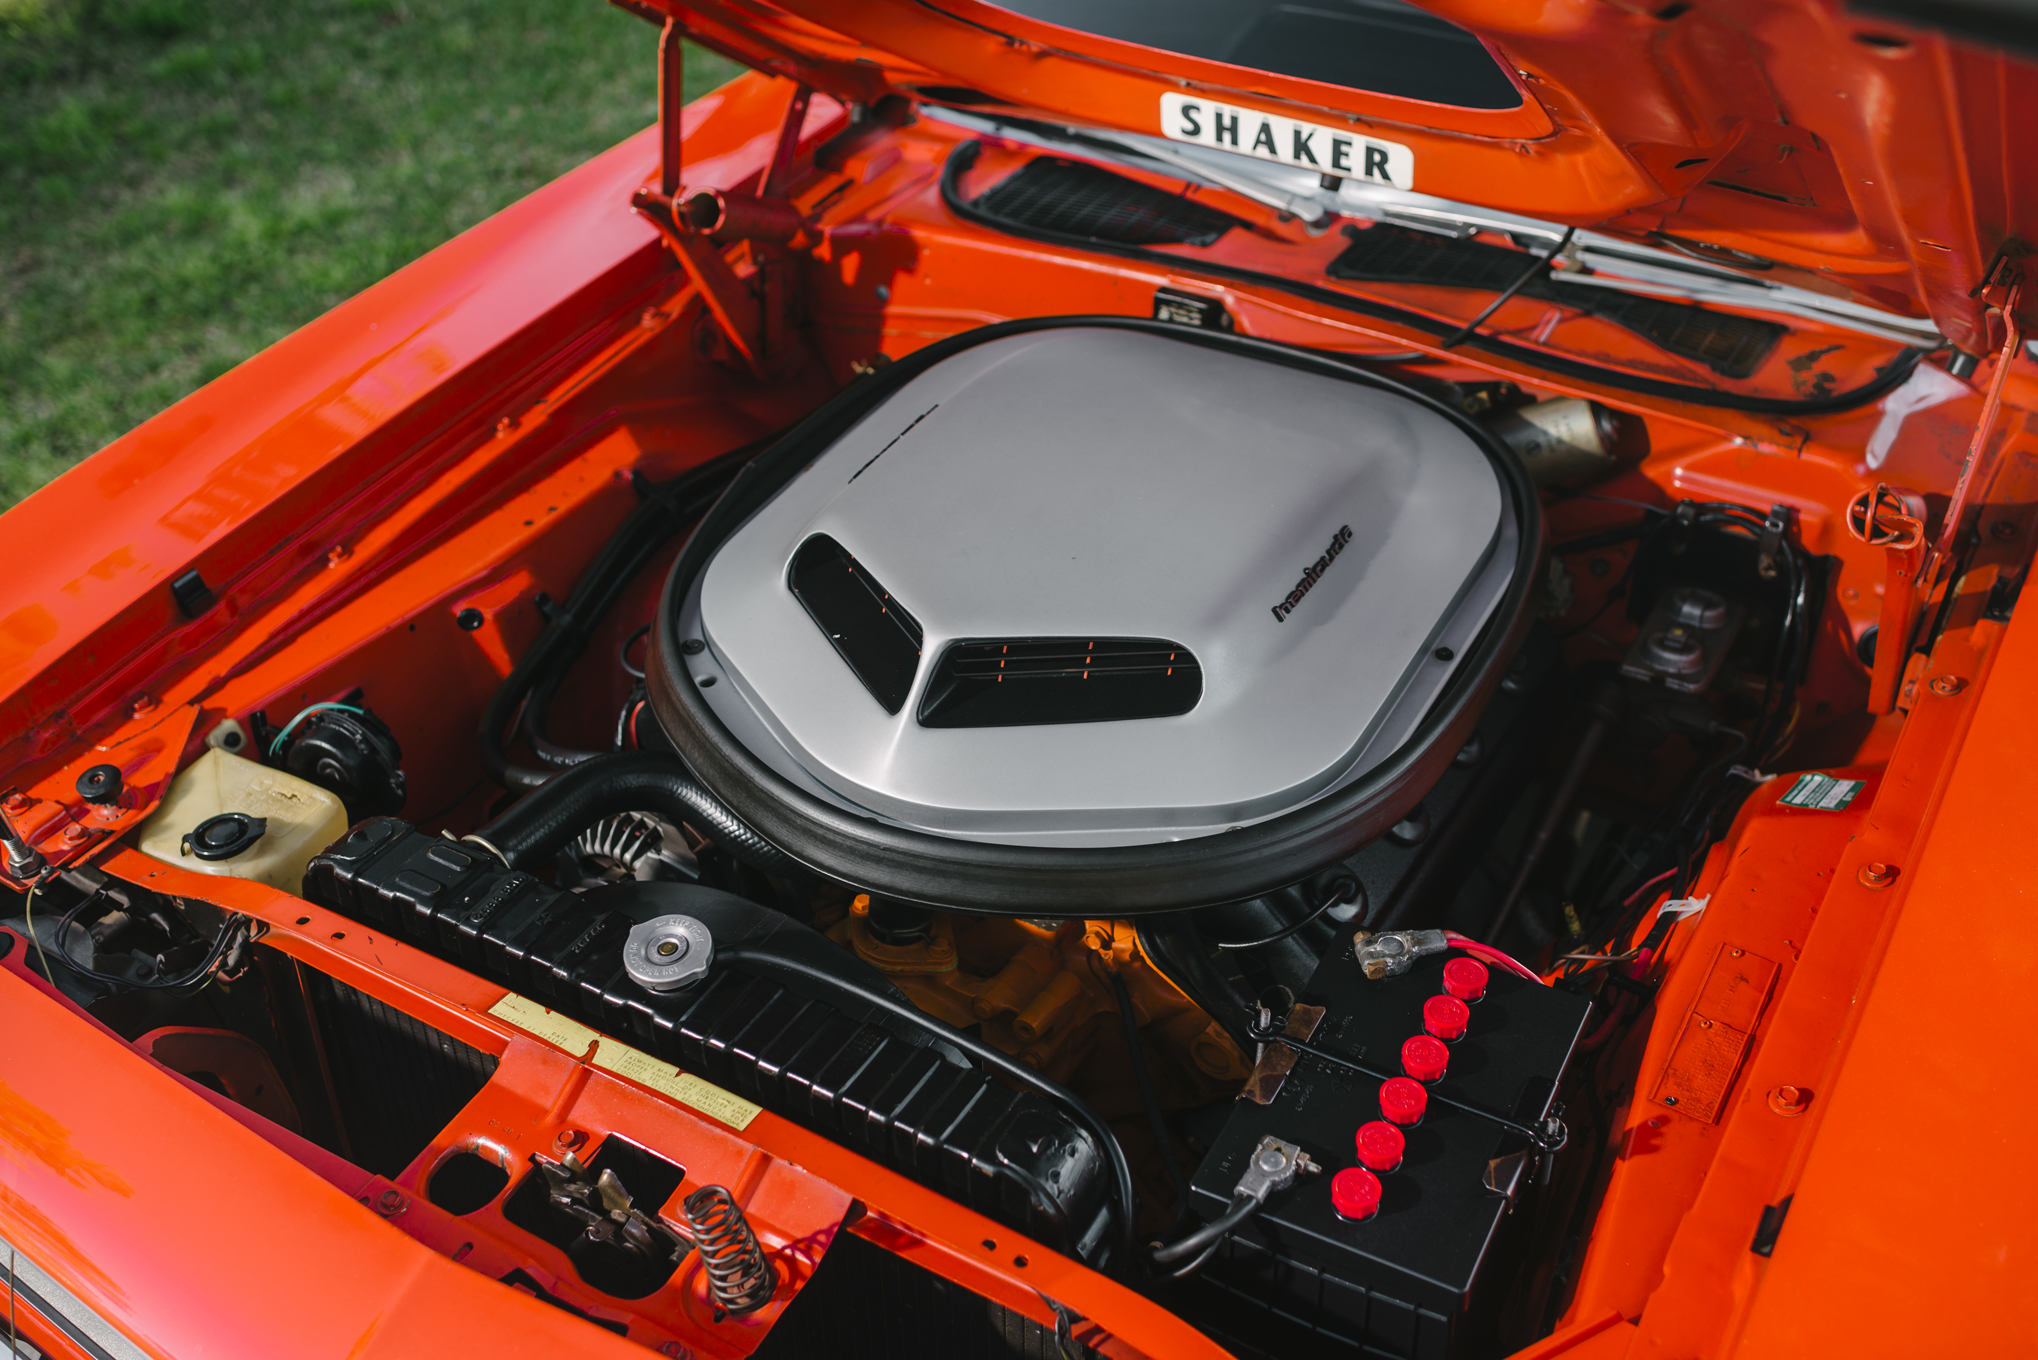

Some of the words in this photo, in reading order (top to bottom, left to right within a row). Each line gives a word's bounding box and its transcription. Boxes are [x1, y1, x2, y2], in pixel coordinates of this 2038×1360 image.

[1180, 102, 1394, 184] SHAKER
[668, 918, 690, 929] KEEP
[550, 1031, 568, 1042] DATE
[615, 1067, 647, 1083] COOLING
[623, 1058, 648, 1072] PROPER
[694, 1090, 728, 1108] CHRYSLER
[627, 1054, 655, 1069] ALWAYS
[736, 1105, 754, 1115] HAS
[648, 1075, 660, 1083] SEE
[694, 1097, 727, 1114] MANUAL
[729, 1114, 745, 1123] FOR
